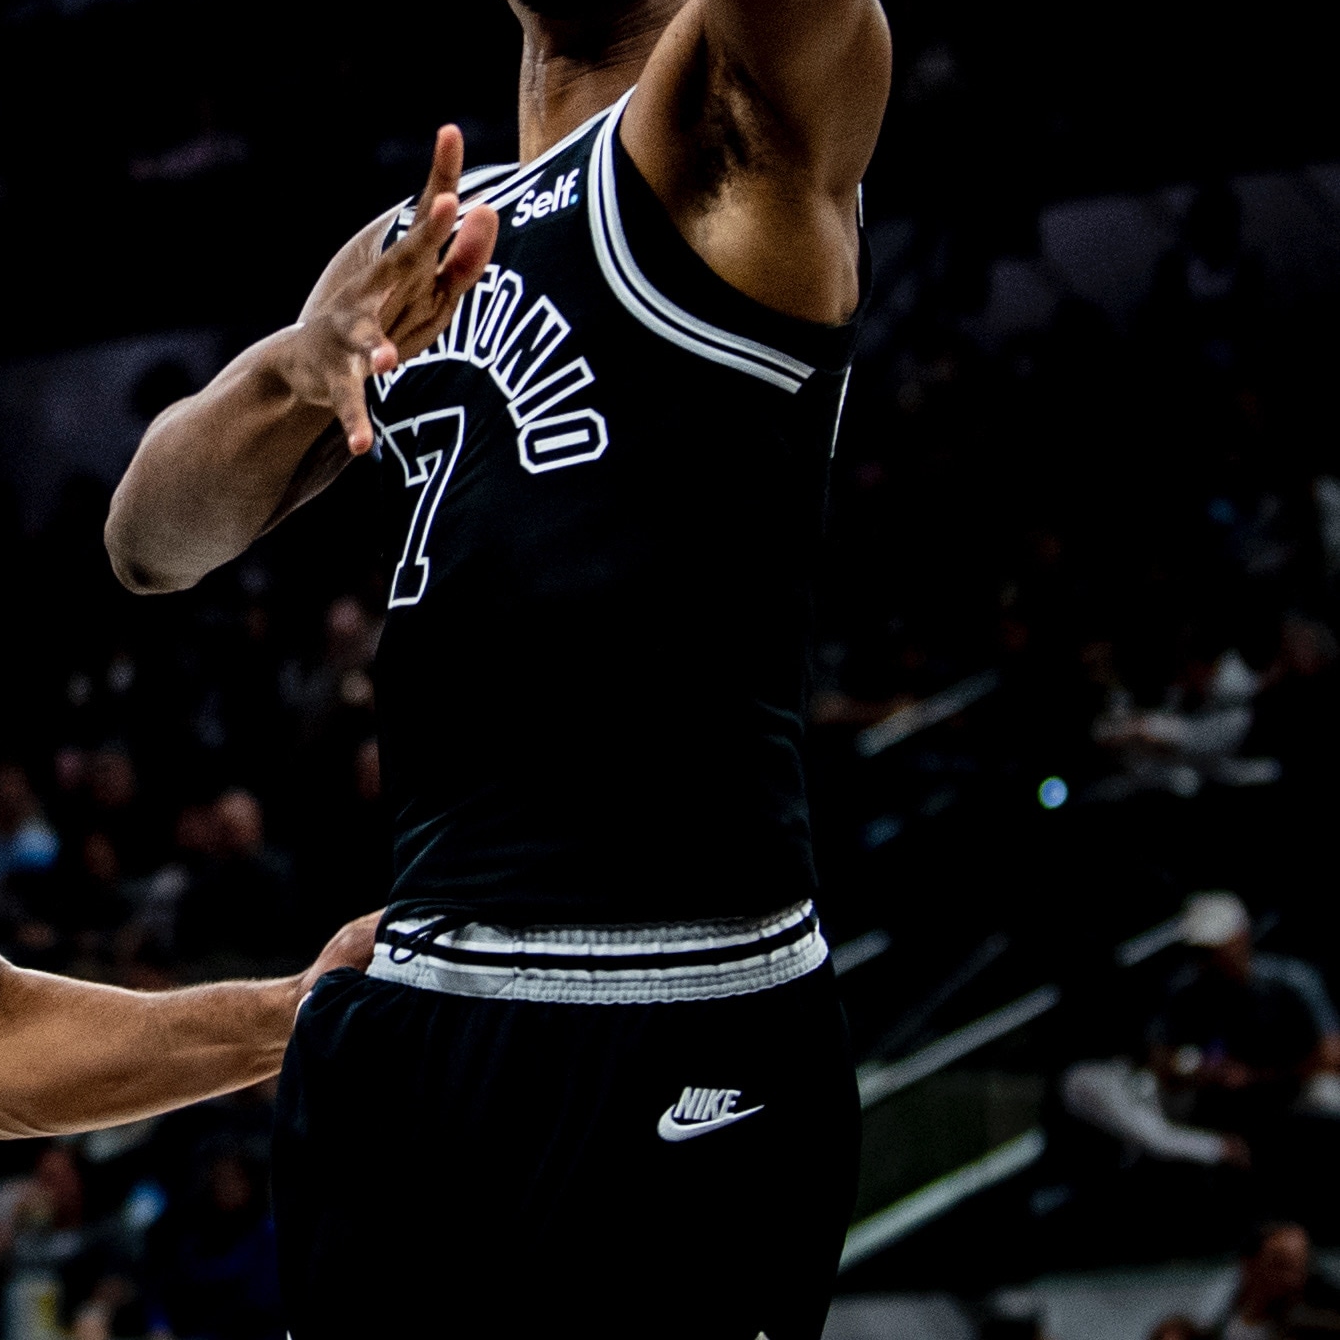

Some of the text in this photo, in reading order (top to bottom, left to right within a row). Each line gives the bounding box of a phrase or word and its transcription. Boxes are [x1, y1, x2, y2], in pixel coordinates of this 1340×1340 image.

[373, 263, 609, 475] TONIO
[382, 405, 465, 610] 7
[673, 1086, 742, 1121] NIKE
